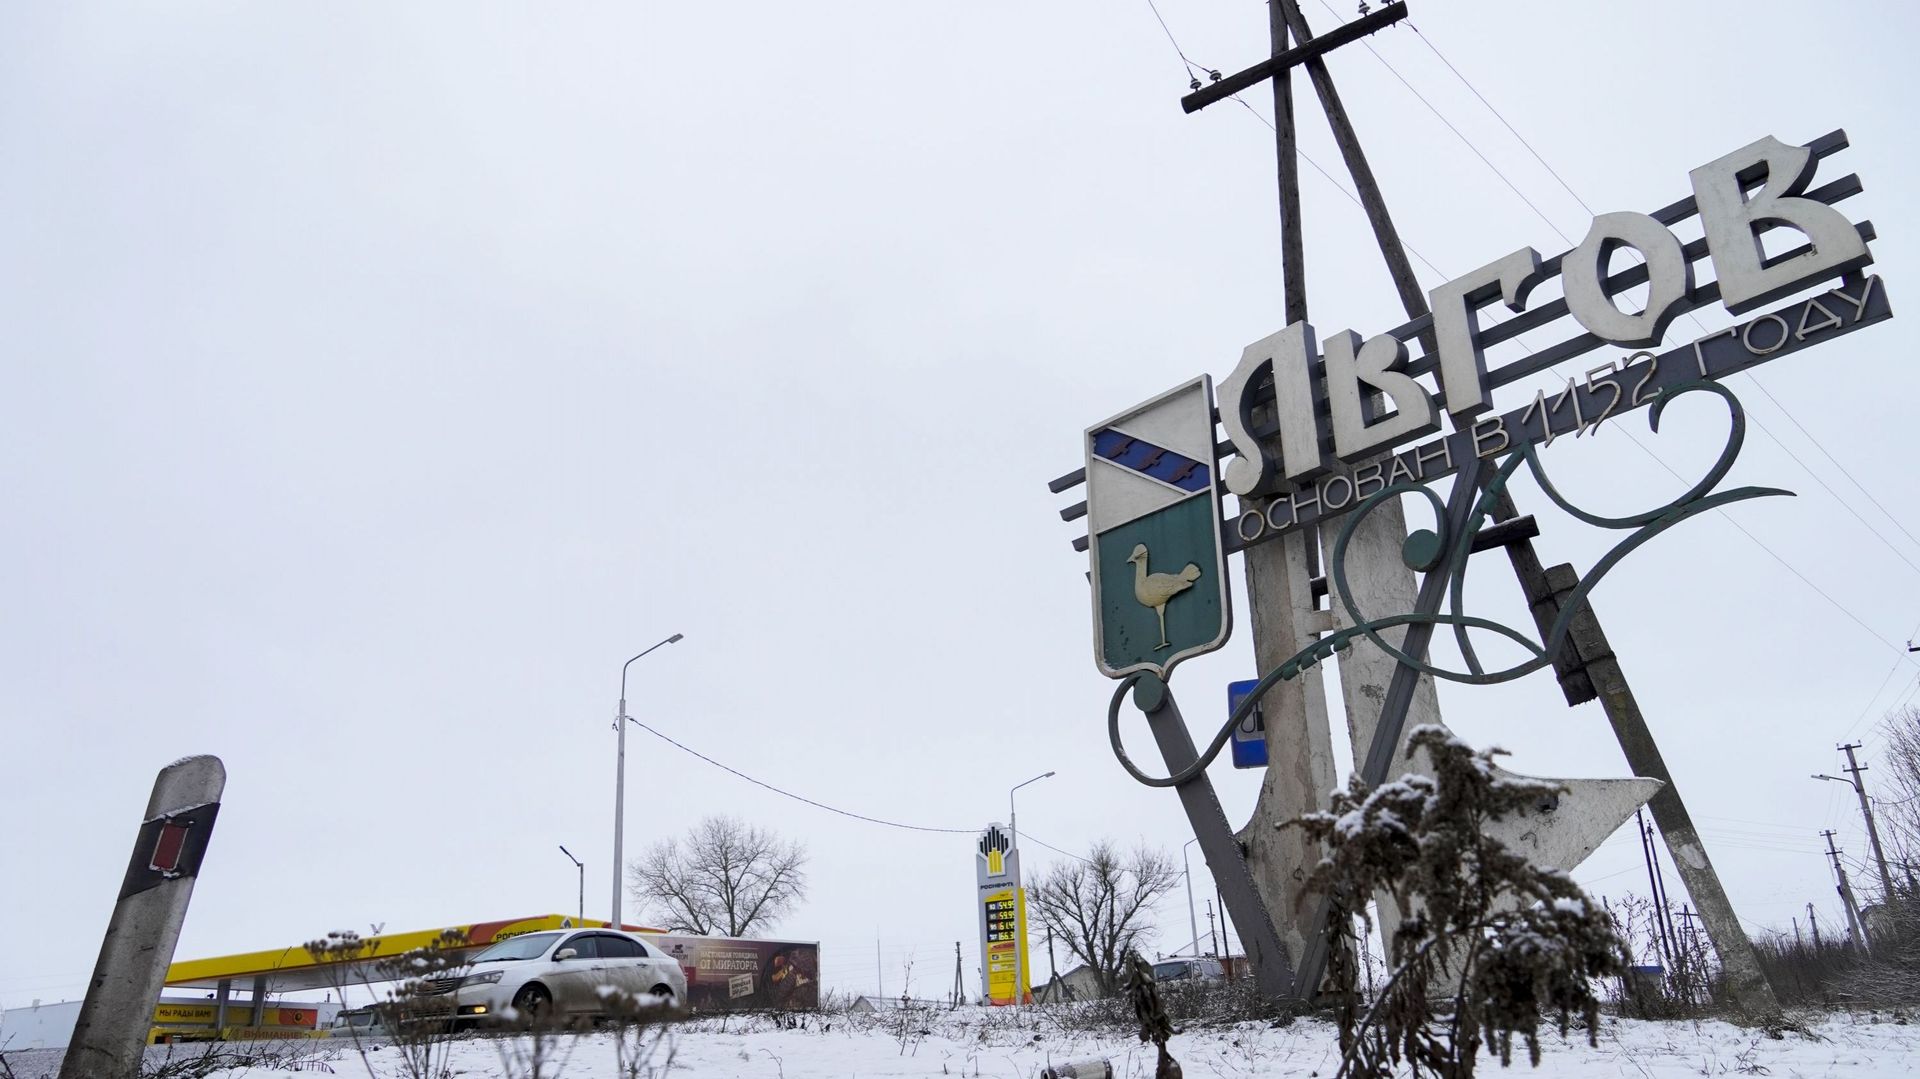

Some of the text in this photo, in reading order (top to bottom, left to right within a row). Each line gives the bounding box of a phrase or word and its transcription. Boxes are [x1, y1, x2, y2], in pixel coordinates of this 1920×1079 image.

[1237, 273, 1878, 541] ОСНОВАН В 1152 ГОДУ
[700, 959, 758, 970] ОТ МИРАТОРГА
[159, 1009, 171, 1017] МЫ
[172, 1009, 193, 1018] РАДЫ
